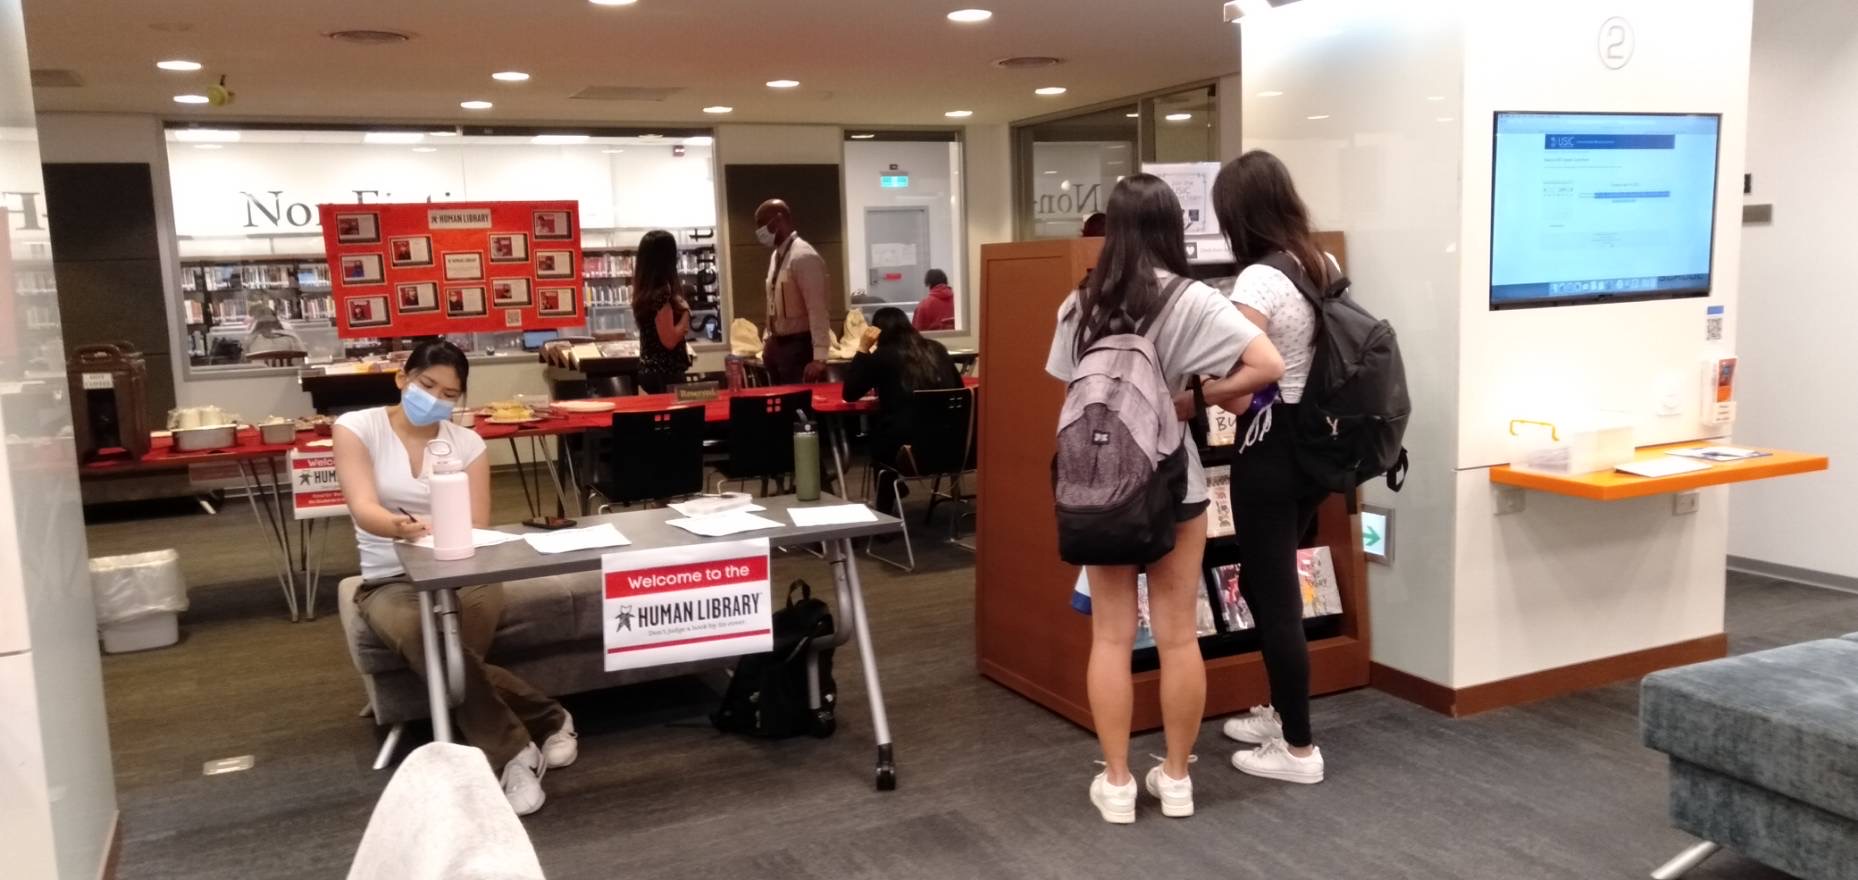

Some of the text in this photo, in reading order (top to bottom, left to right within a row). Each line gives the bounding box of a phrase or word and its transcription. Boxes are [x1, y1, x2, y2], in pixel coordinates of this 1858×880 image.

[1607, 25, 1625, 59] 2
[628, 565, 750, 590] Welcome to the
[638, 592, 760, 628] HUMAN LIBRARY
